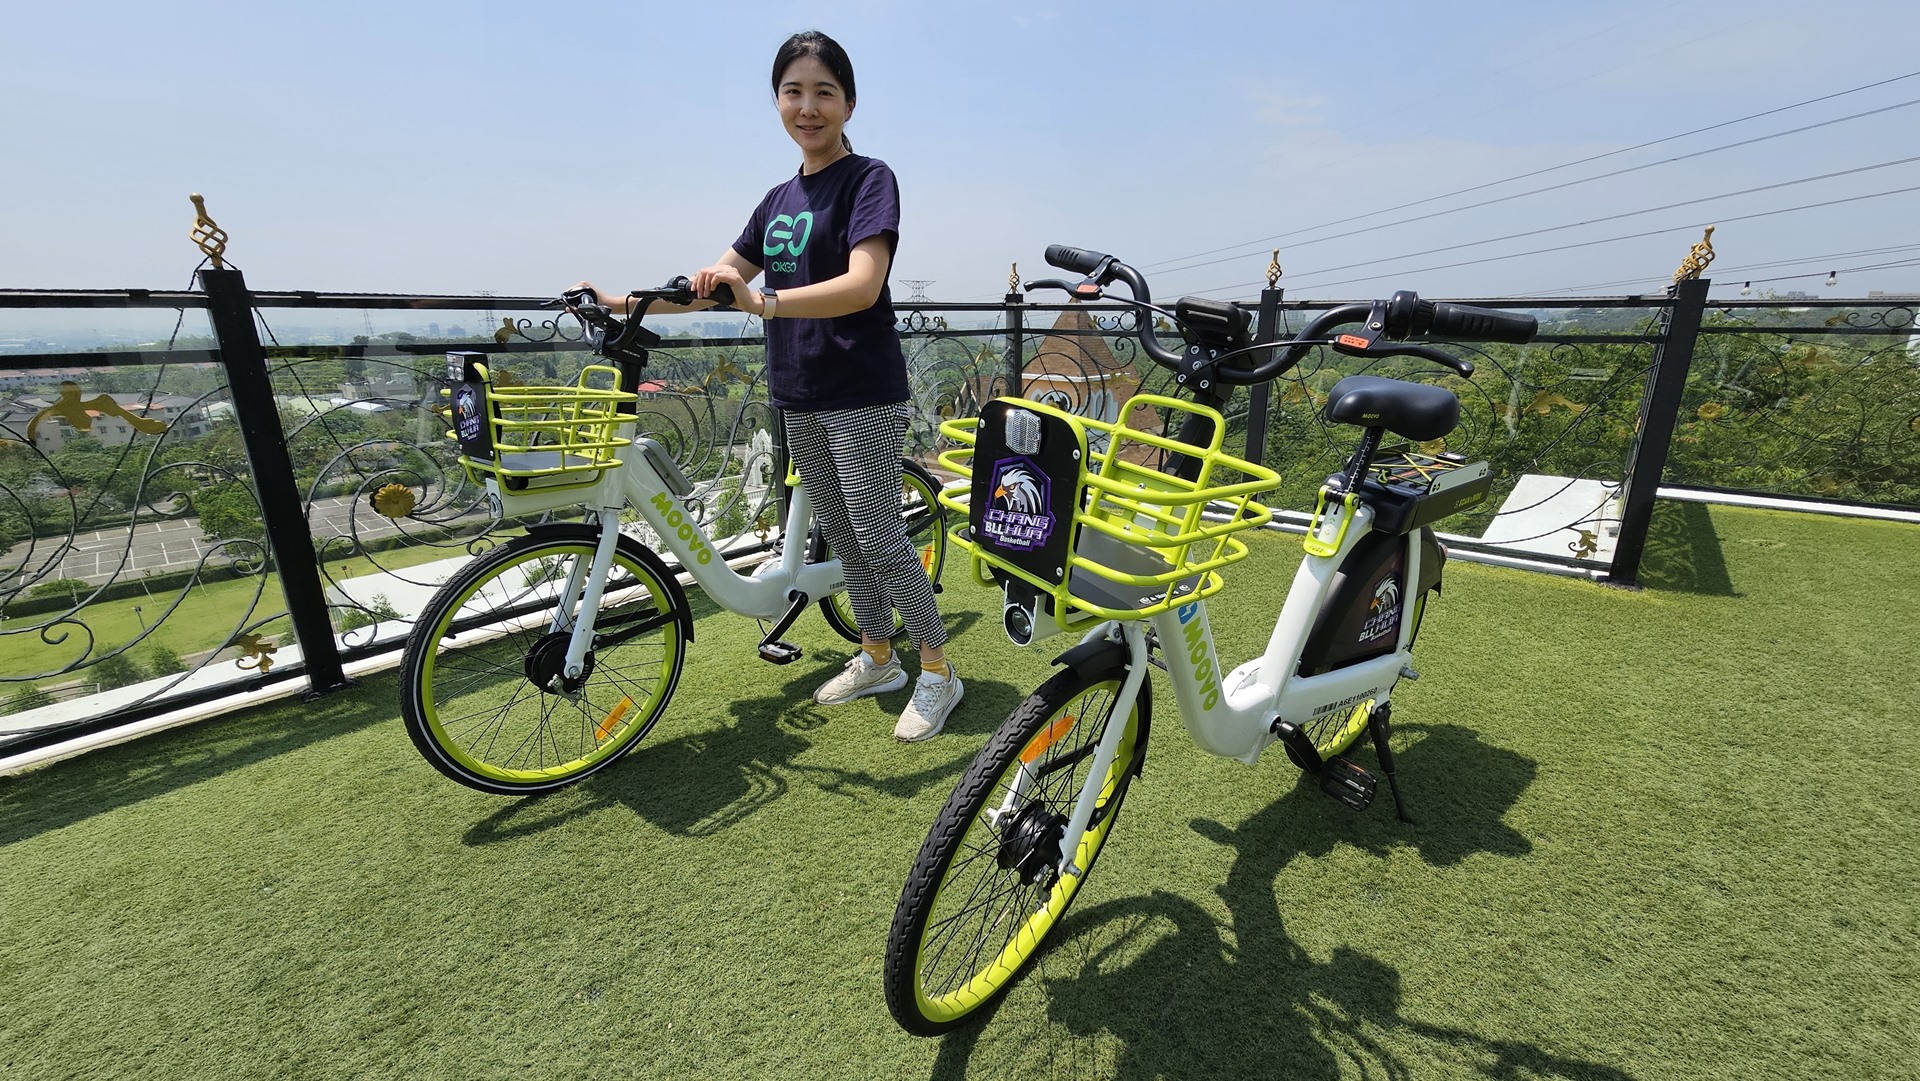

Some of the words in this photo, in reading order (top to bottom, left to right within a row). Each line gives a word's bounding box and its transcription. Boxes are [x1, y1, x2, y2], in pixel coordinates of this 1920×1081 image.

[771, 261, 797, 273] OKGO
[650, 491, 712, 565] MOOVO
[989, 508, 1050, 530] CHANG
[984, 521, 1004, 535] BLL
[1004, 523, 1043, 540] HUA
[1000, 535, 1031, 547] Basketball
[1183, 616, 1219, 711] MOOVO
